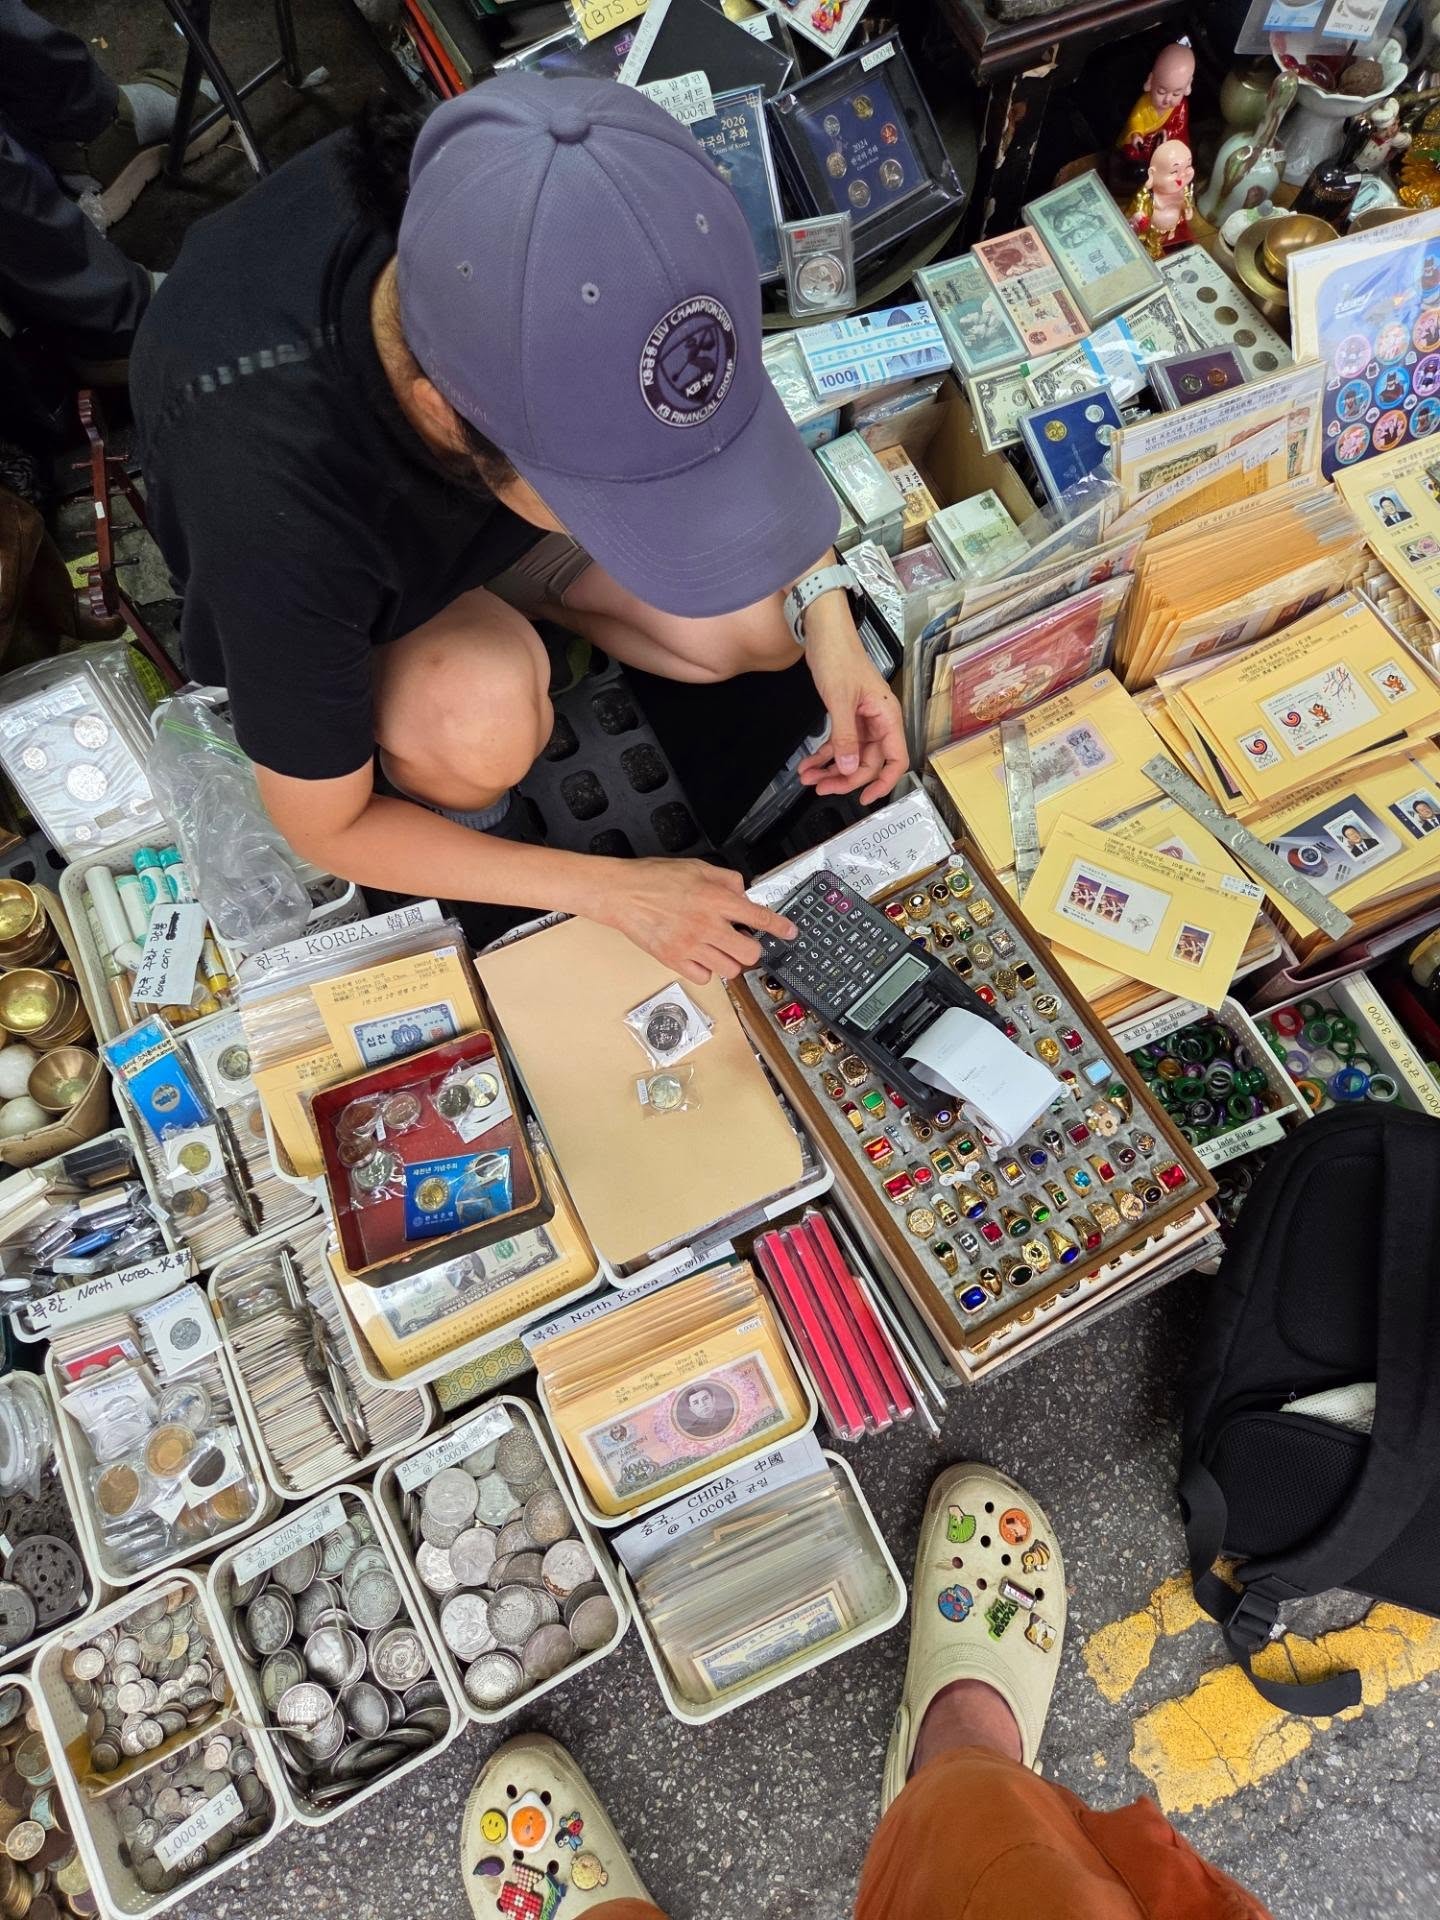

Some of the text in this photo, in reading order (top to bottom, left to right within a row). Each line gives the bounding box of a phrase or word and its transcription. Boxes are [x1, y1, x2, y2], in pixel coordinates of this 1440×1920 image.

[720, 114, 746, 131] 2026
[729, 126, 748, 144] 주화
[670, 300, 732, 333] CHAMPIONSHIP
[657, 358, 734, 424] KB FINANCIAL GROUP
[685, 381, 701, 397] KB
[819, 368, 854, 388] 1000
[255, 906, 424, 971] 한국. KOREA. 韓國
[161, 948, 174, 970] coin
[1150, 1016, 1170, 1029] Jade
[1169, 1009, 1187, 1022] Ring
[1367, 1005, 1393, 1035] 3,000
[1216, 1135, 1235, 1150] Jade
[412, 1162, 459, 1177] 새천년 기념주화
[30, 1295, 73, 1319] 북한.
[77, 1279, 114, 1302] North
[531, 1322, 566, 1342] 북한.
[569, 1299, 613, 1324] North
[616, 1276, 665, 1302] Korea.
[640, 1451, 786, 1537] 중국. CHINA. 中國
[667, 1523, 681, 1536] @
[687, 1491, 738, 1526] 1,000원
[274, 1524, 307, 1547] CHINA.
[162, 1789, 239, 1858] 1,000원 균일
